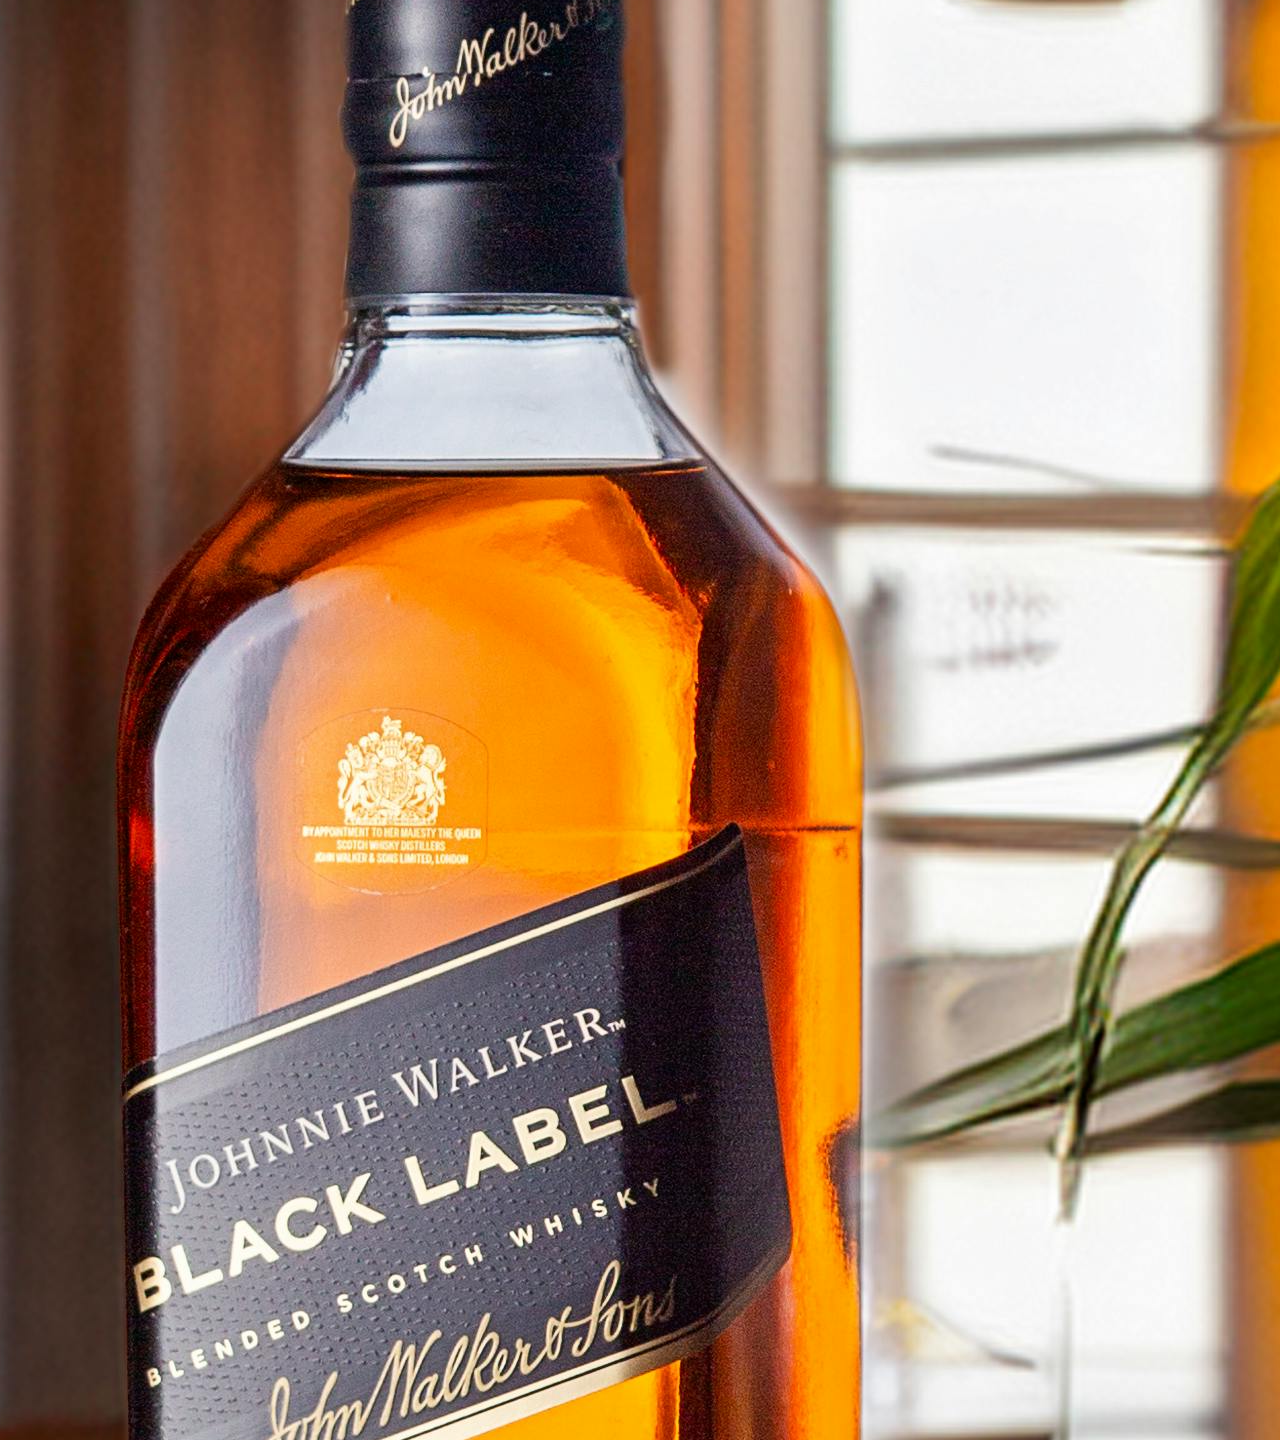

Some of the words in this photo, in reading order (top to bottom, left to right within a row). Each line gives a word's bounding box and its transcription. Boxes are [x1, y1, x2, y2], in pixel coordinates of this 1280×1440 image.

[389, 68, 467, 148] John
[457, 12, 566, 86] Walker
[335, 852, 368, 863] WALKER
[376, 852, 398, 863] SONS
[400, 852, 434, 865] LIMITED,
[435, 853, 469, 864] LONDON
[336, 840, 368, 850] SCOTCH
[369, 840, 400, 851] WHISKY
[400, 840, 446, 851] DISTILLERS
[372, 827, 383, 838] TO
[384, 827, 400, 838] HER
[400, 827, 437, 838] MAJESTY
[438, 827, 453, 839] THE
[454, 827, 482, 840] QUEEN
[133, 1173, 387, 1313] BLACK
[404, 1075, 677, 1205] LABEL
[166, 1090, 385, 1215] JOHNNIE
[146, 1310, 311, 1388] BLENDED
[336, 1244, 484, 1313] SCOTCH
[509, 1178, 660, 1248] WHISKY
[370, 1312, 542, 1427] Walker
[571, 1259, 678, 1358] Sons
